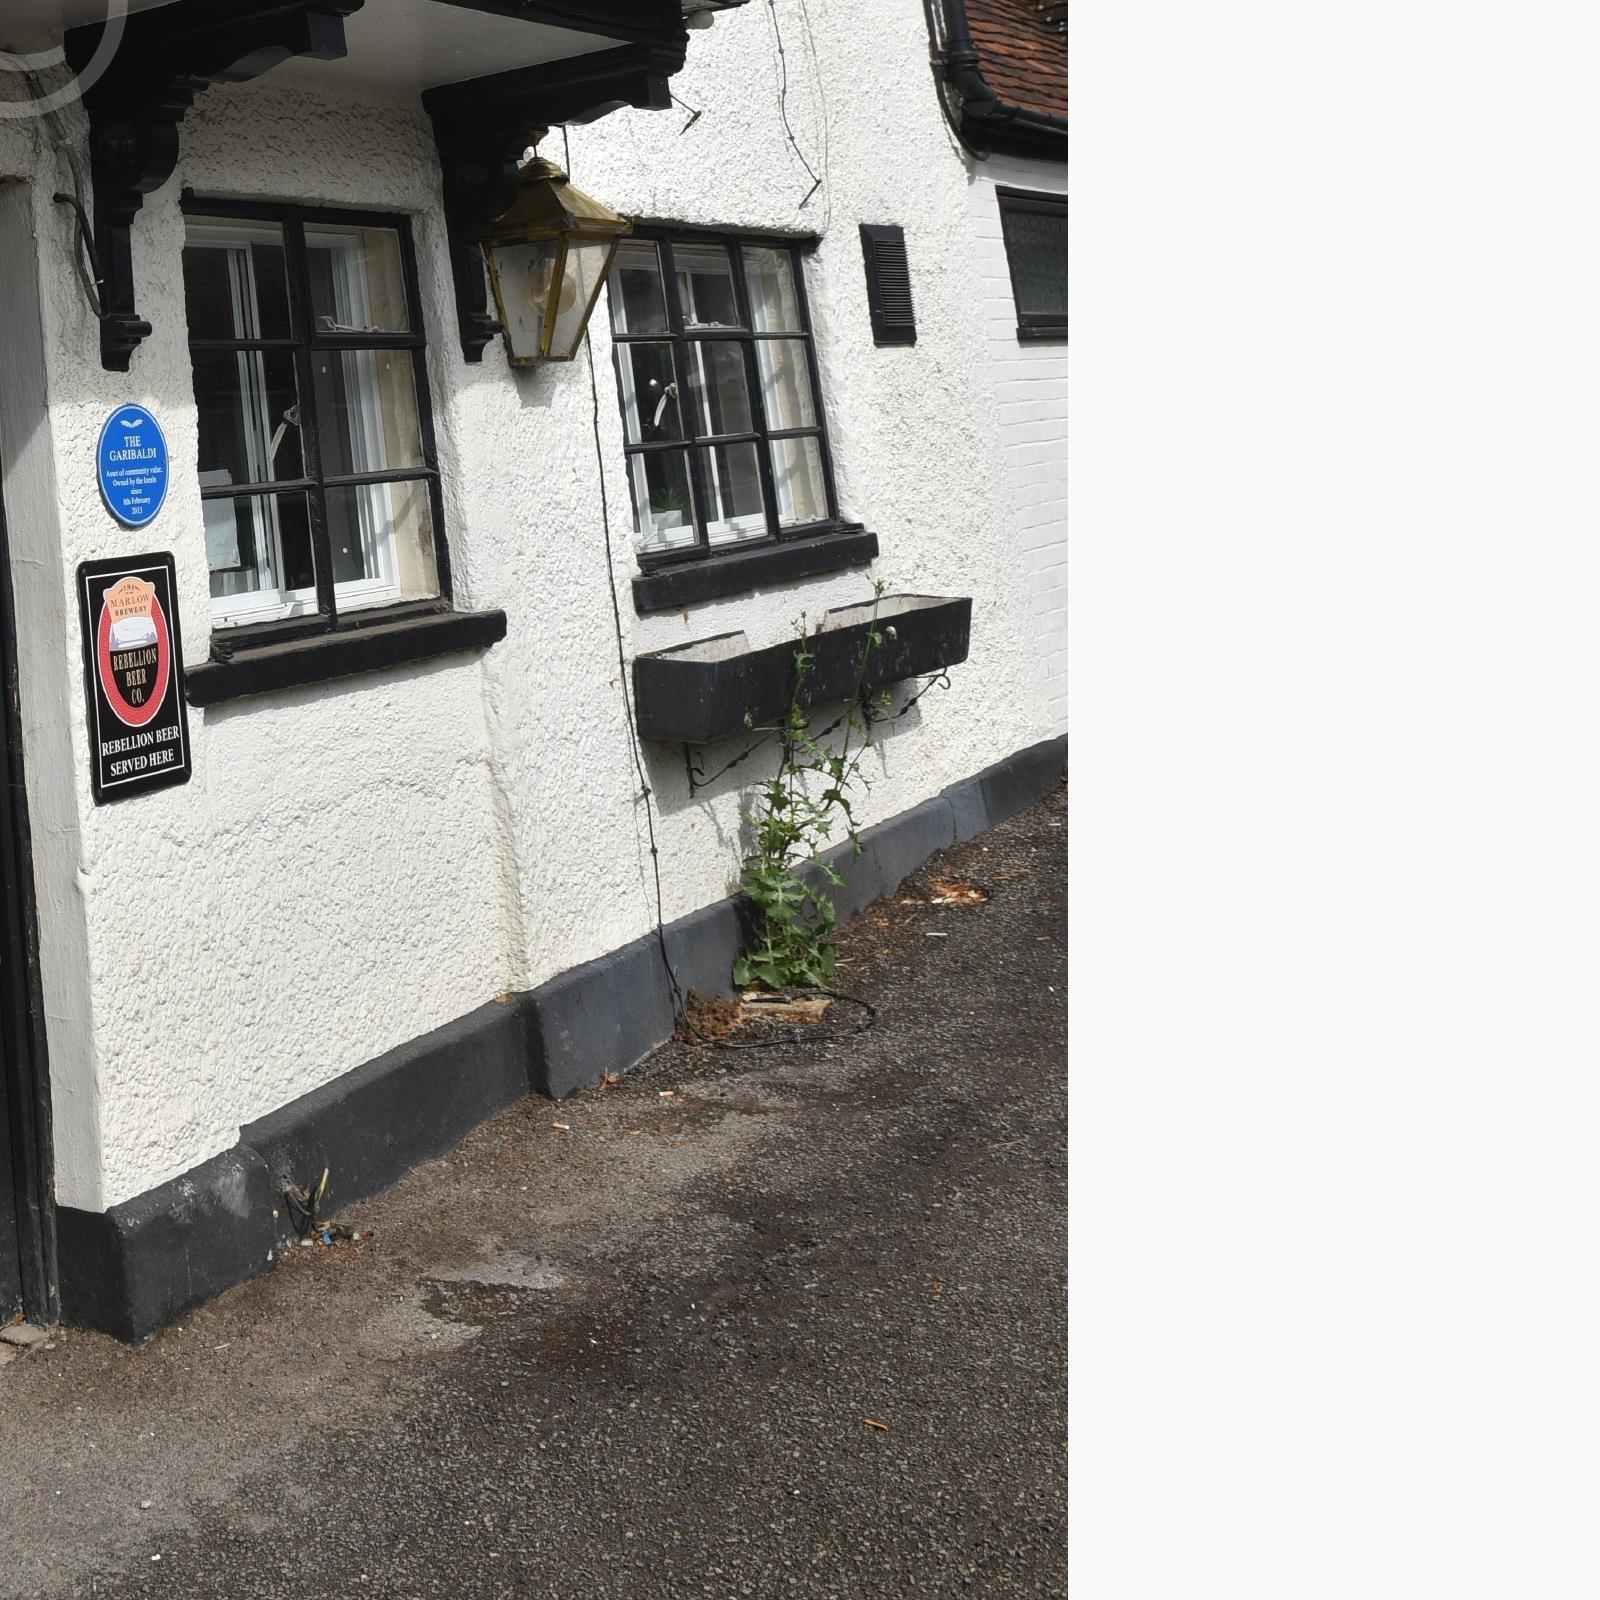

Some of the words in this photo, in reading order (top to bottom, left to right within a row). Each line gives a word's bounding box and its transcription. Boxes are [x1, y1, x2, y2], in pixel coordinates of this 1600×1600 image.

[123, 435, 141, 447] THE
[109, 448, 156, 461] GARIBALDI
[119, 468, 125, 476] of
[125, 467, 149, 475] community
[112, 478, 129, 486] Owned
[129, 478, 135, 487] by
[135, 477, 143, 485] the
[131, 497, 151, 505] February
[110, 593, 150, 608] MARLOW
[115, 605, 147, 616] BREWERY
[113, 648, 157, 671] REBELLION
[126, 668, 147, 687] BEER
[131, 688, 145, 704] CO.
[102, 731, 154, 757] REBELLION
[156, 725, 180, 743] BEER
[110, 755, 148, 777] SERVED
[149, 748, 175, 767] HERE
